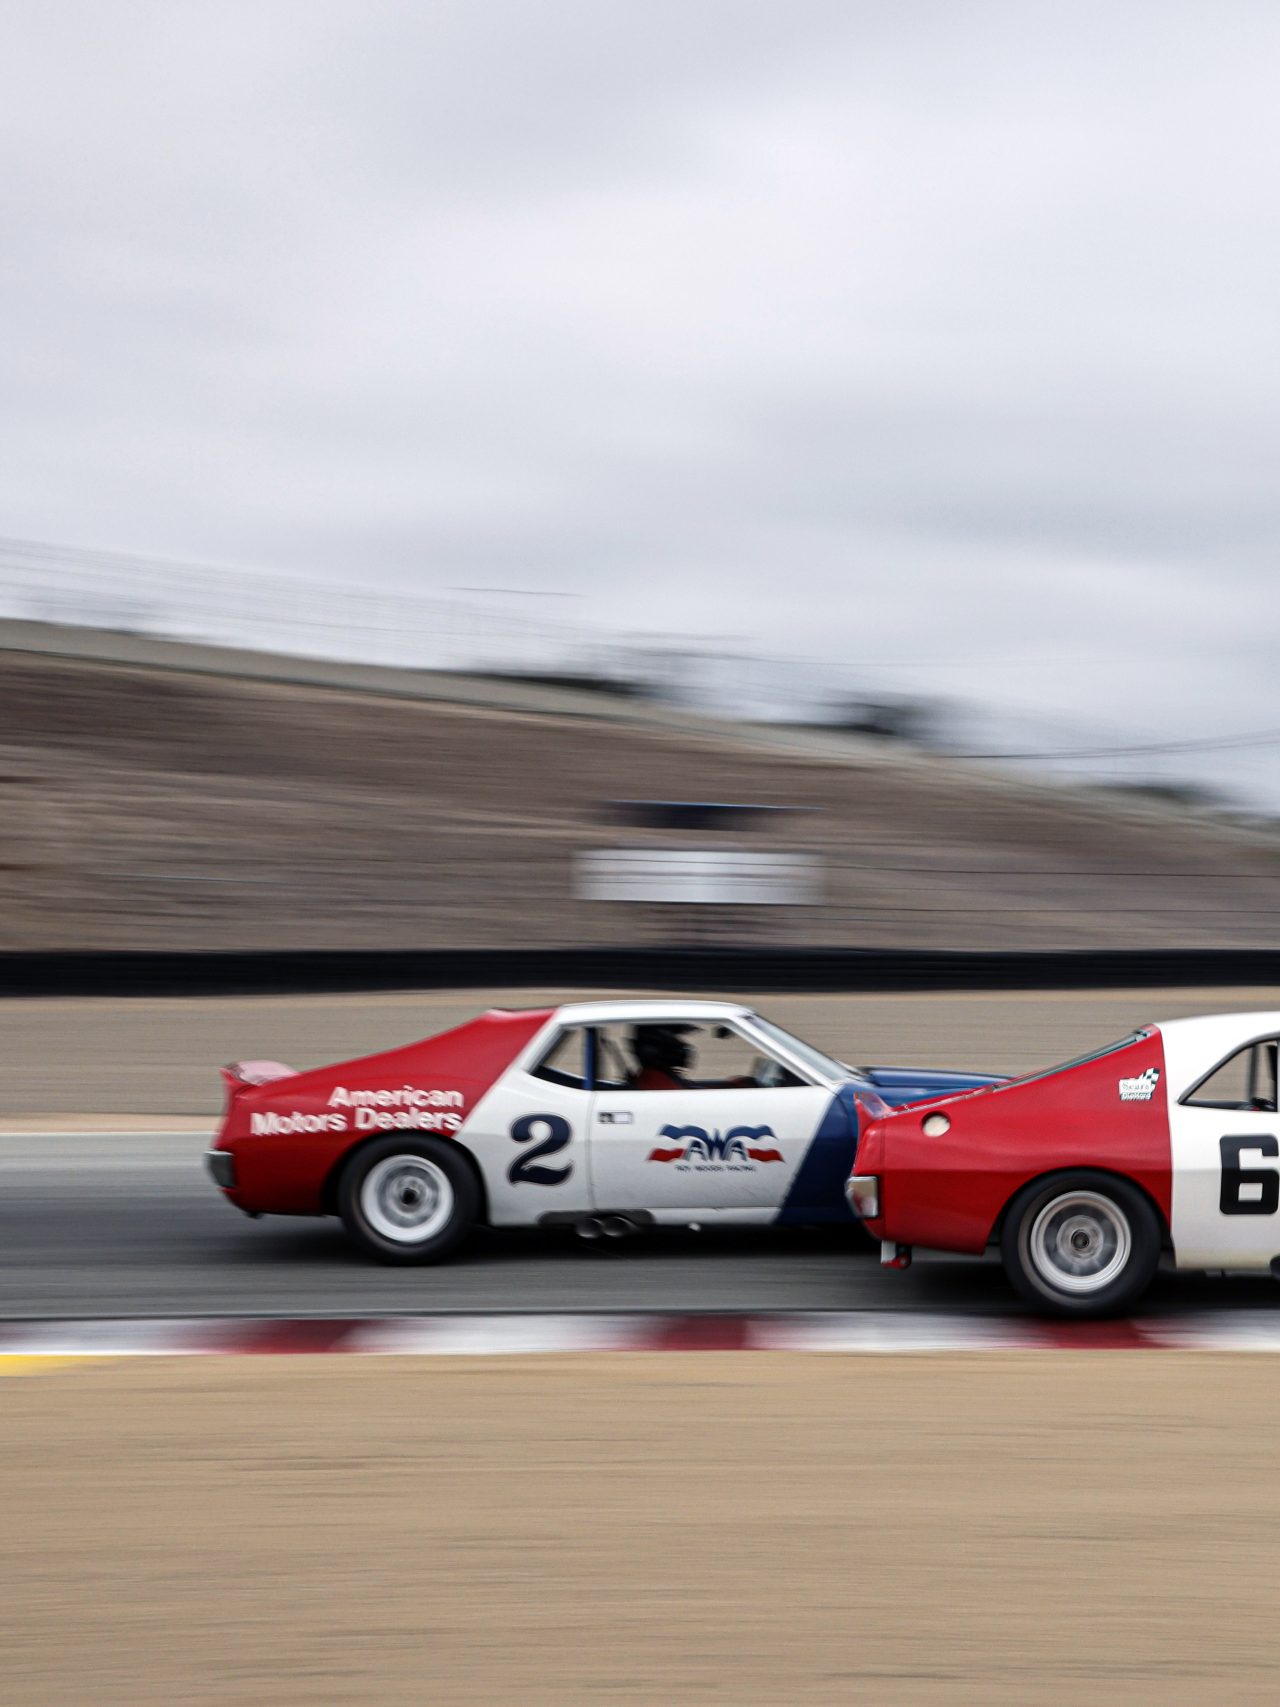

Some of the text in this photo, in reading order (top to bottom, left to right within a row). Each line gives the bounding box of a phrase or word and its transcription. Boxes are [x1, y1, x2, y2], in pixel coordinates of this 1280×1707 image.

[250, 1108, 466, 1136] Motors Dealers
[327, 1085, 465, 1108] American
[509, 1113, 574, 1187] 2
[1219, 1134, 1280, 1216] 6
